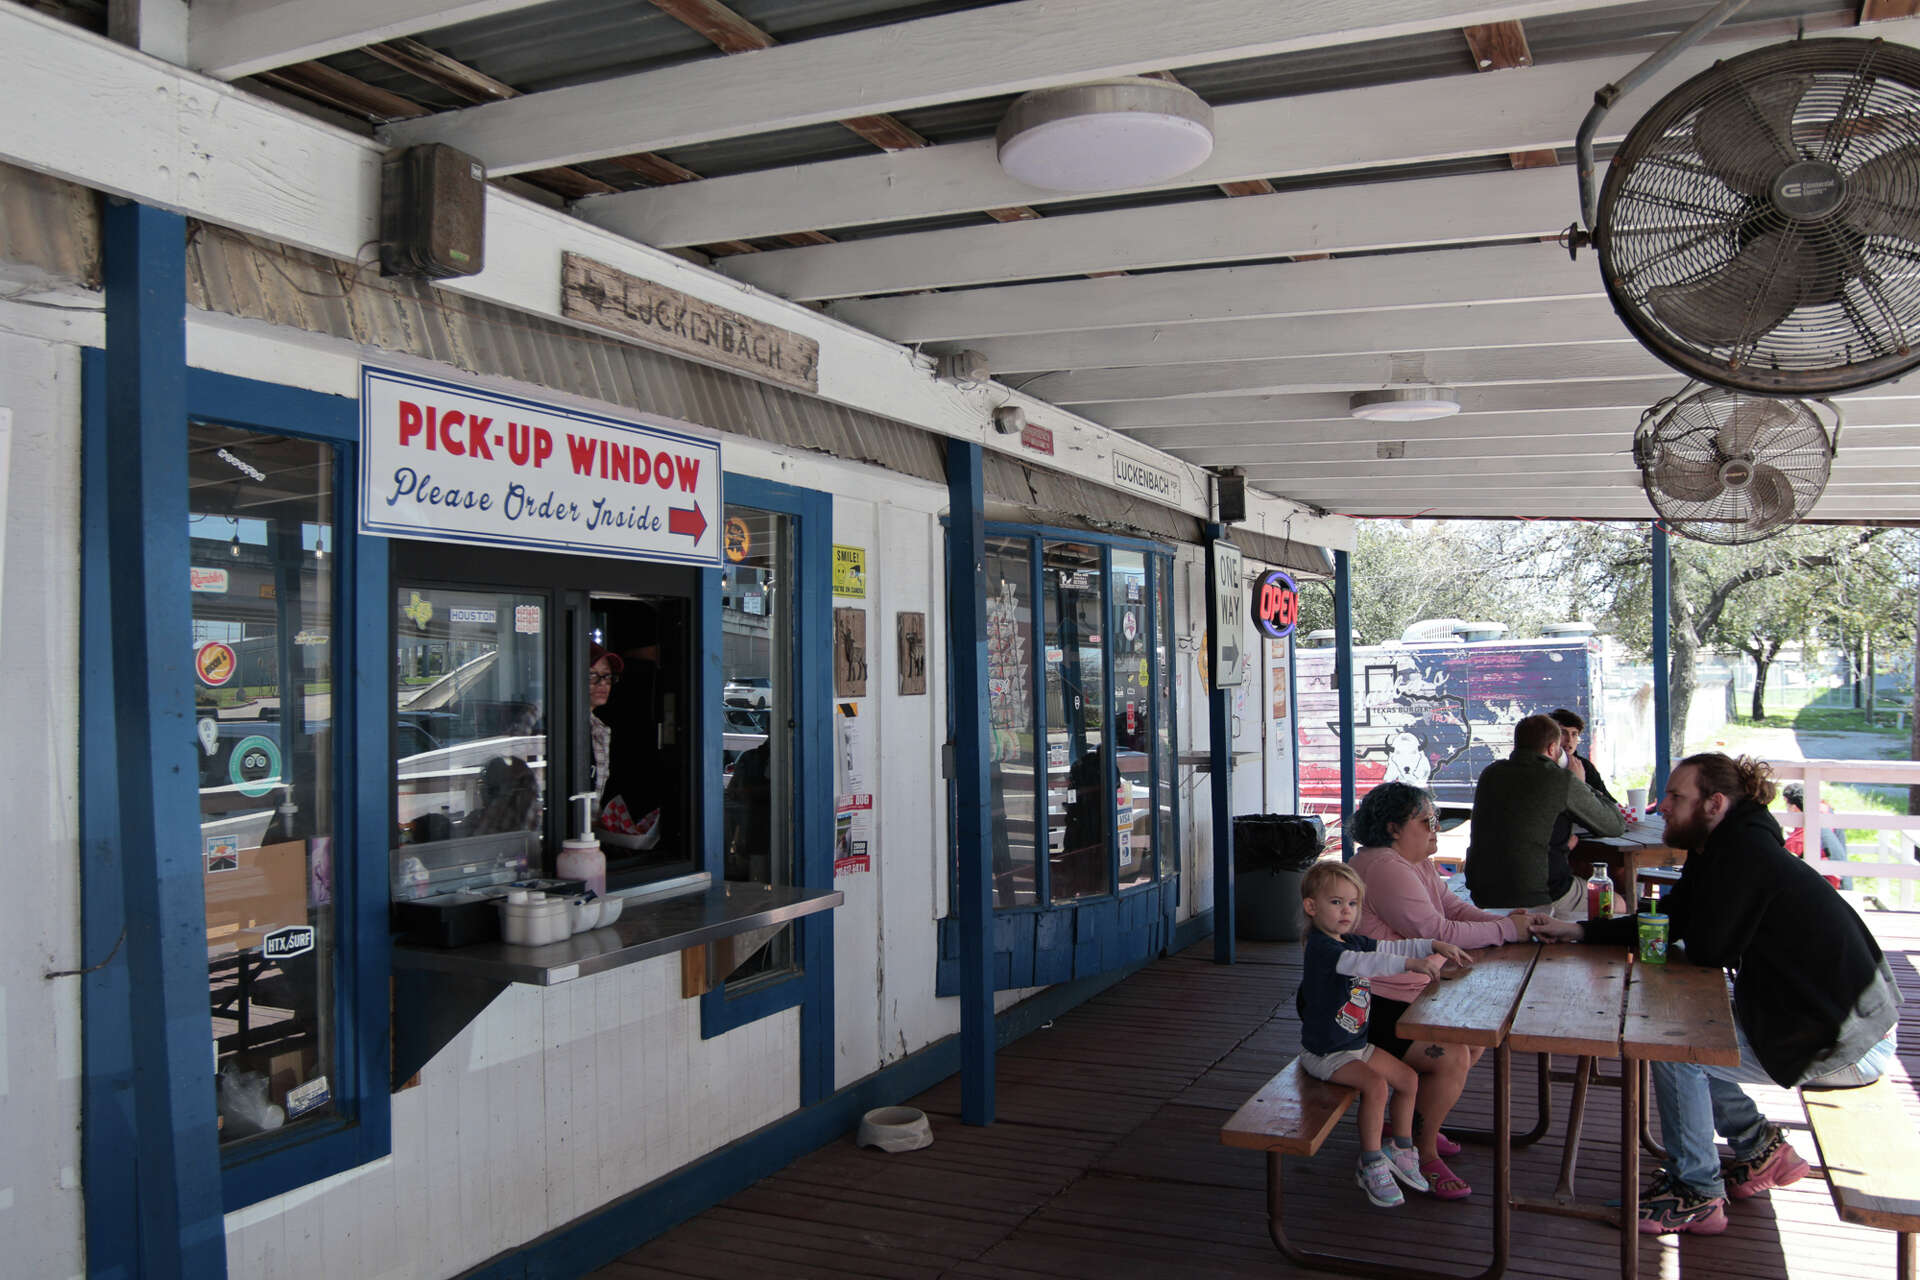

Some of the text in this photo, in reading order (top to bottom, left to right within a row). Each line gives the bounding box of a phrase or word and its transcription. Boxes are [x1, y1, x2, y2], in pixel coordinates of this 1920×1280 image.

[623, 281, 782, 370] LUCKENBACH
[398, 400, 700, 494] PICK-UP WINDOW
[1116, 459, 1169, 496] LUCKENBACH
[386, 467, 662, 532] Please Order Inside
[837, 550, 859, 563] SMILE!
[1220, 555, 1239, 589] ONE
[451, 610, 495, 621] HOUSTON
[1220, 594, 1240, 626] WAY
[1260, 584, 1299, 626] OPEN
